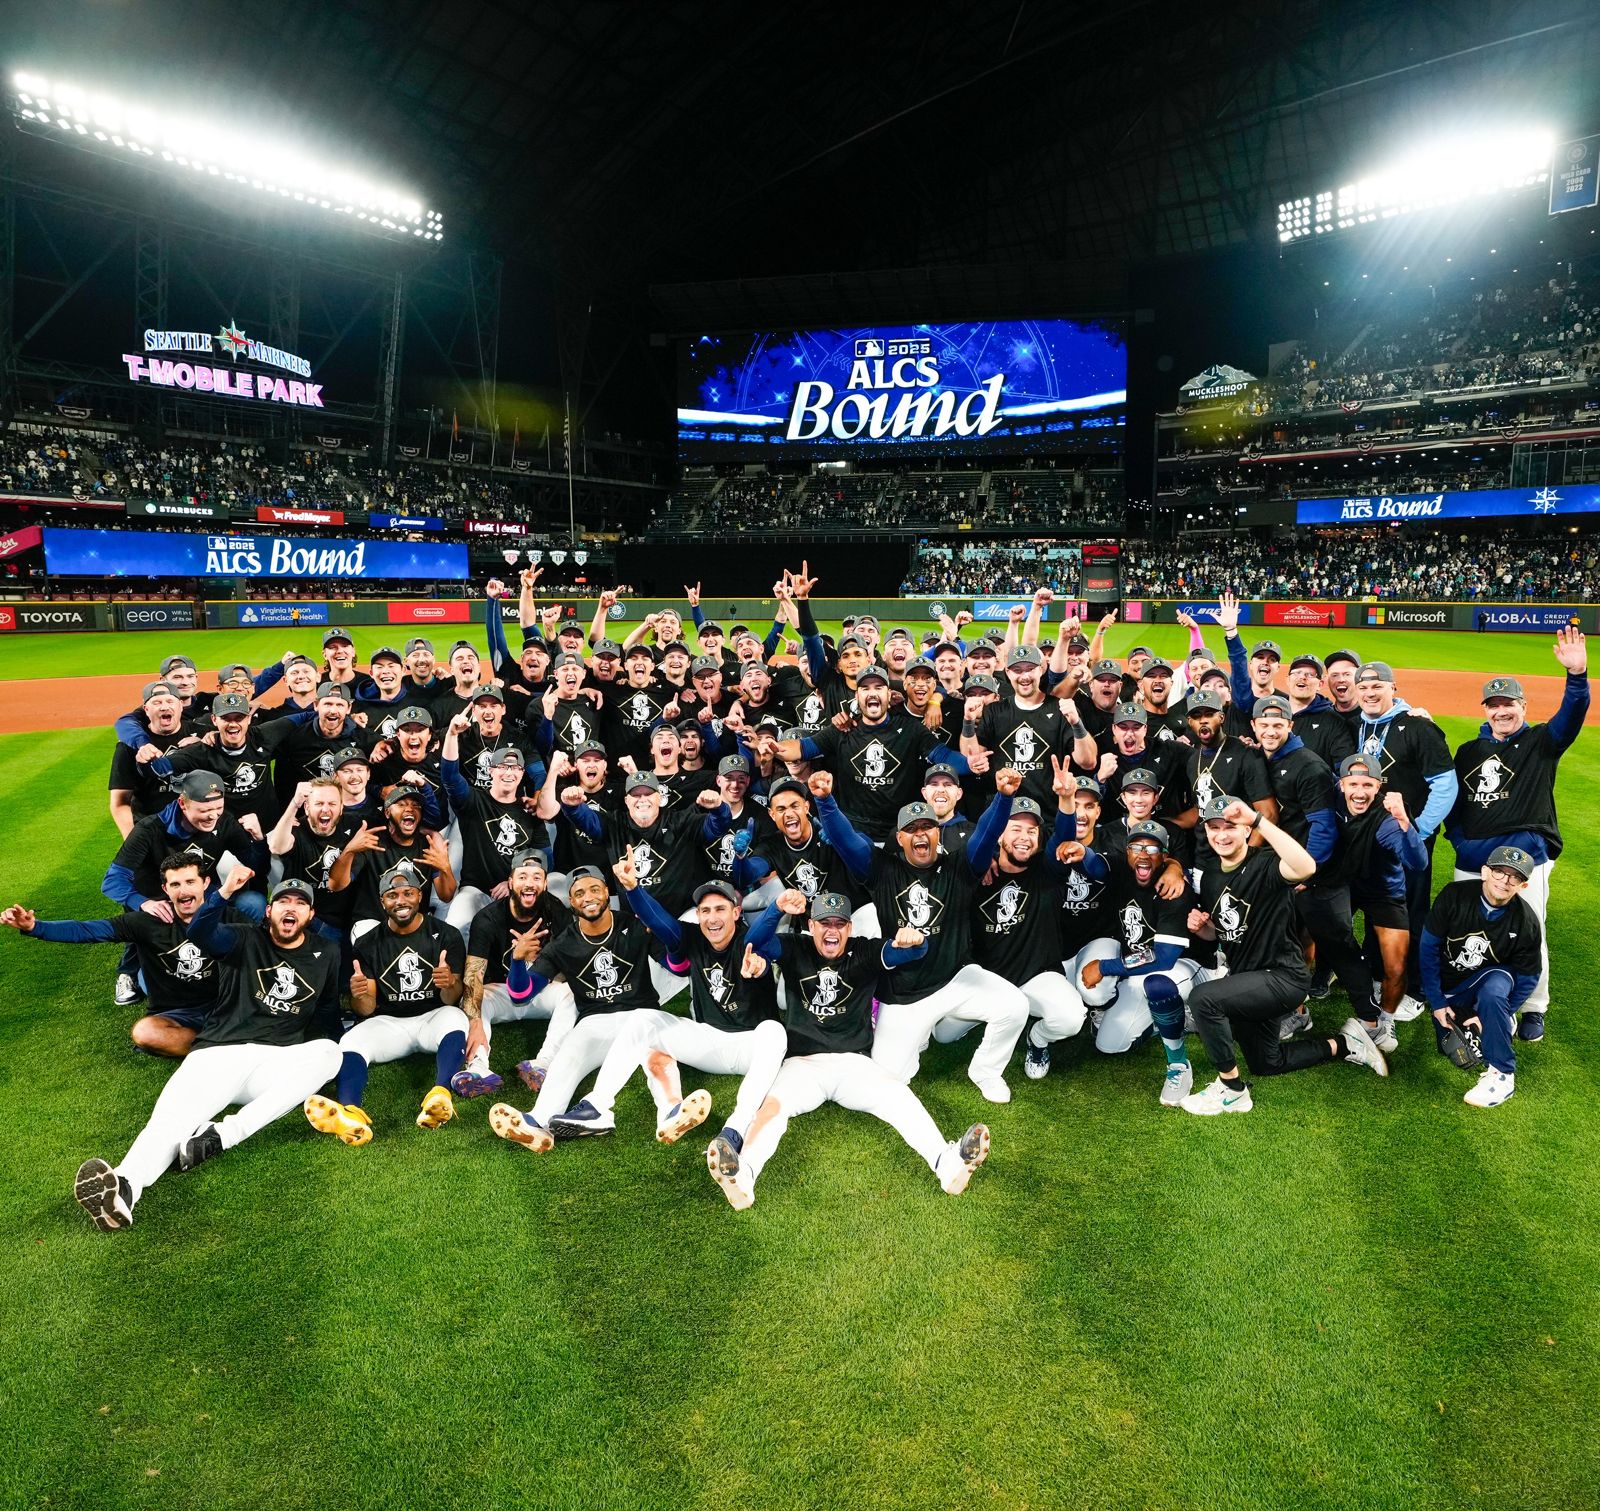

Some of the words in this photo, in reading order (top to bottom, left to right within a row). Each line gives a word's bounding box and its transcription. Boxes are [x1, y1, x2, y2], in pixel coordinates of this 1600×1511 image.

[144, 329, 213, 352] SEATTLE
[246, 338, 312, 378] MARINERS
[888, 343, 931, 356] 2025
[847, 357, 939, 390] ALCS
[122, 353, 254, 398] T-MOBILE
[257, 375, 325, 407] PARK
[1188, 382, 1249, 397] MUCKLESHOOT
[786, 373, 1004, 441] Bound
[159, 505, 214, 516] STARBUCKS
[1340, 506, 1373, 519] ALCS
[1377, 495, 1444, 518] Bound
[229, 542, 255, 551] 2025
[205, 552, 262, 574] ALCS
[270, 539, 366, 576] Bound
[126, 610, 167, 623] eero
[259, 607, 287, 615] Virginia
[1388, 610, 1446, 623] Microsoft
[20, 612, 83, 623] TOYOTA
[630, 720, 651, 728] ALCS
[1012, 761, 1036, 771] ALCS
[862, 776, 886, 785] ALCS
[1474, 792, 1501, 802] ALCS
[716, 864, 733, 872] ALC
[1063, 901, 1090, 911] ALCS
[398, 991, 425, 1002] ALCS
[596, 985, 623, 998] ALCS
[262, 995, 292, 1012] ALCS
[808, 1004, 836, 1016] ALCS
